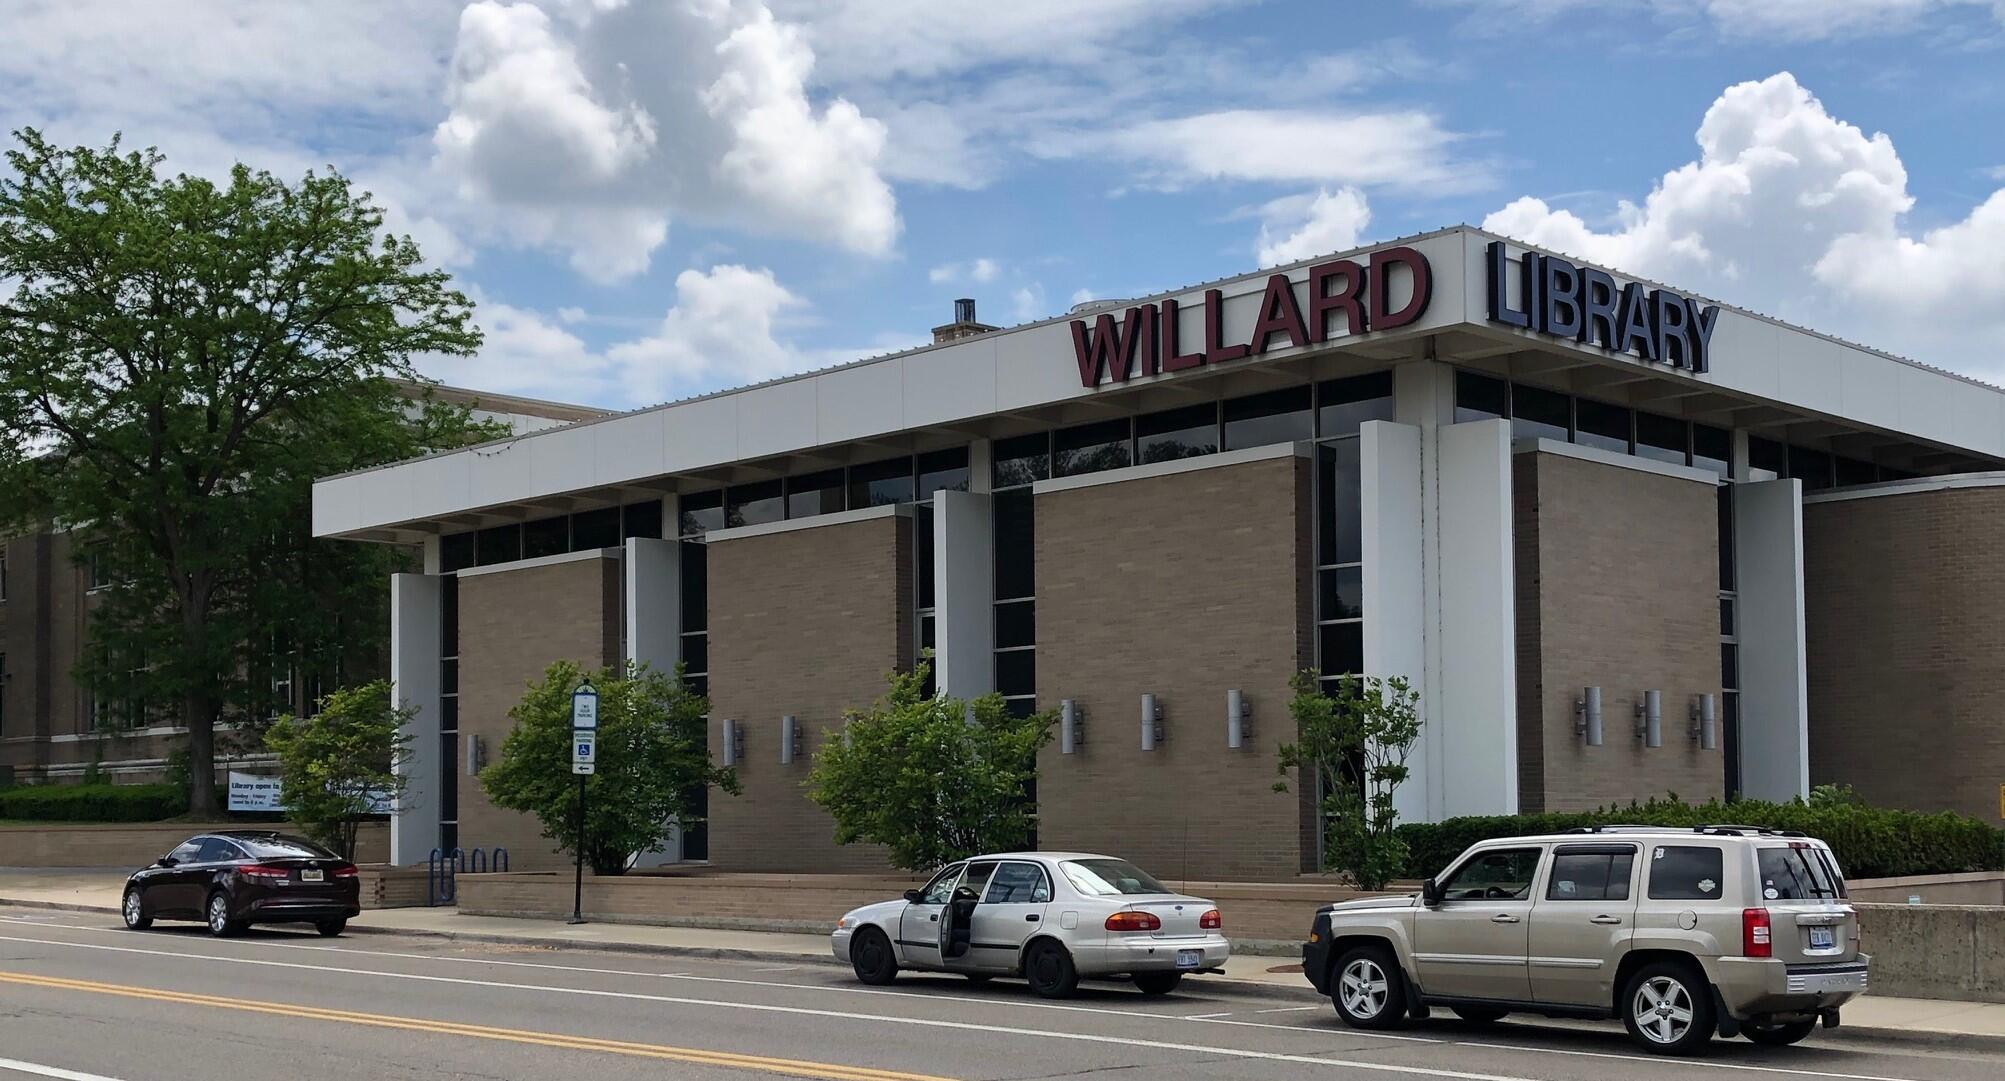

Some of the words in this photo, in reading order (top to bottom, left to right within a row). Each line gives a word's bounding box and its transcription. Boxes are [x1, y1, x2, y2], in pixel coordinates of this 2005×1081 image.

[1070, 247, 1432, 387] WILLARD
[1486, 241, 1719, 373] LIBRARY
[231, 782, 253, 790] Library
